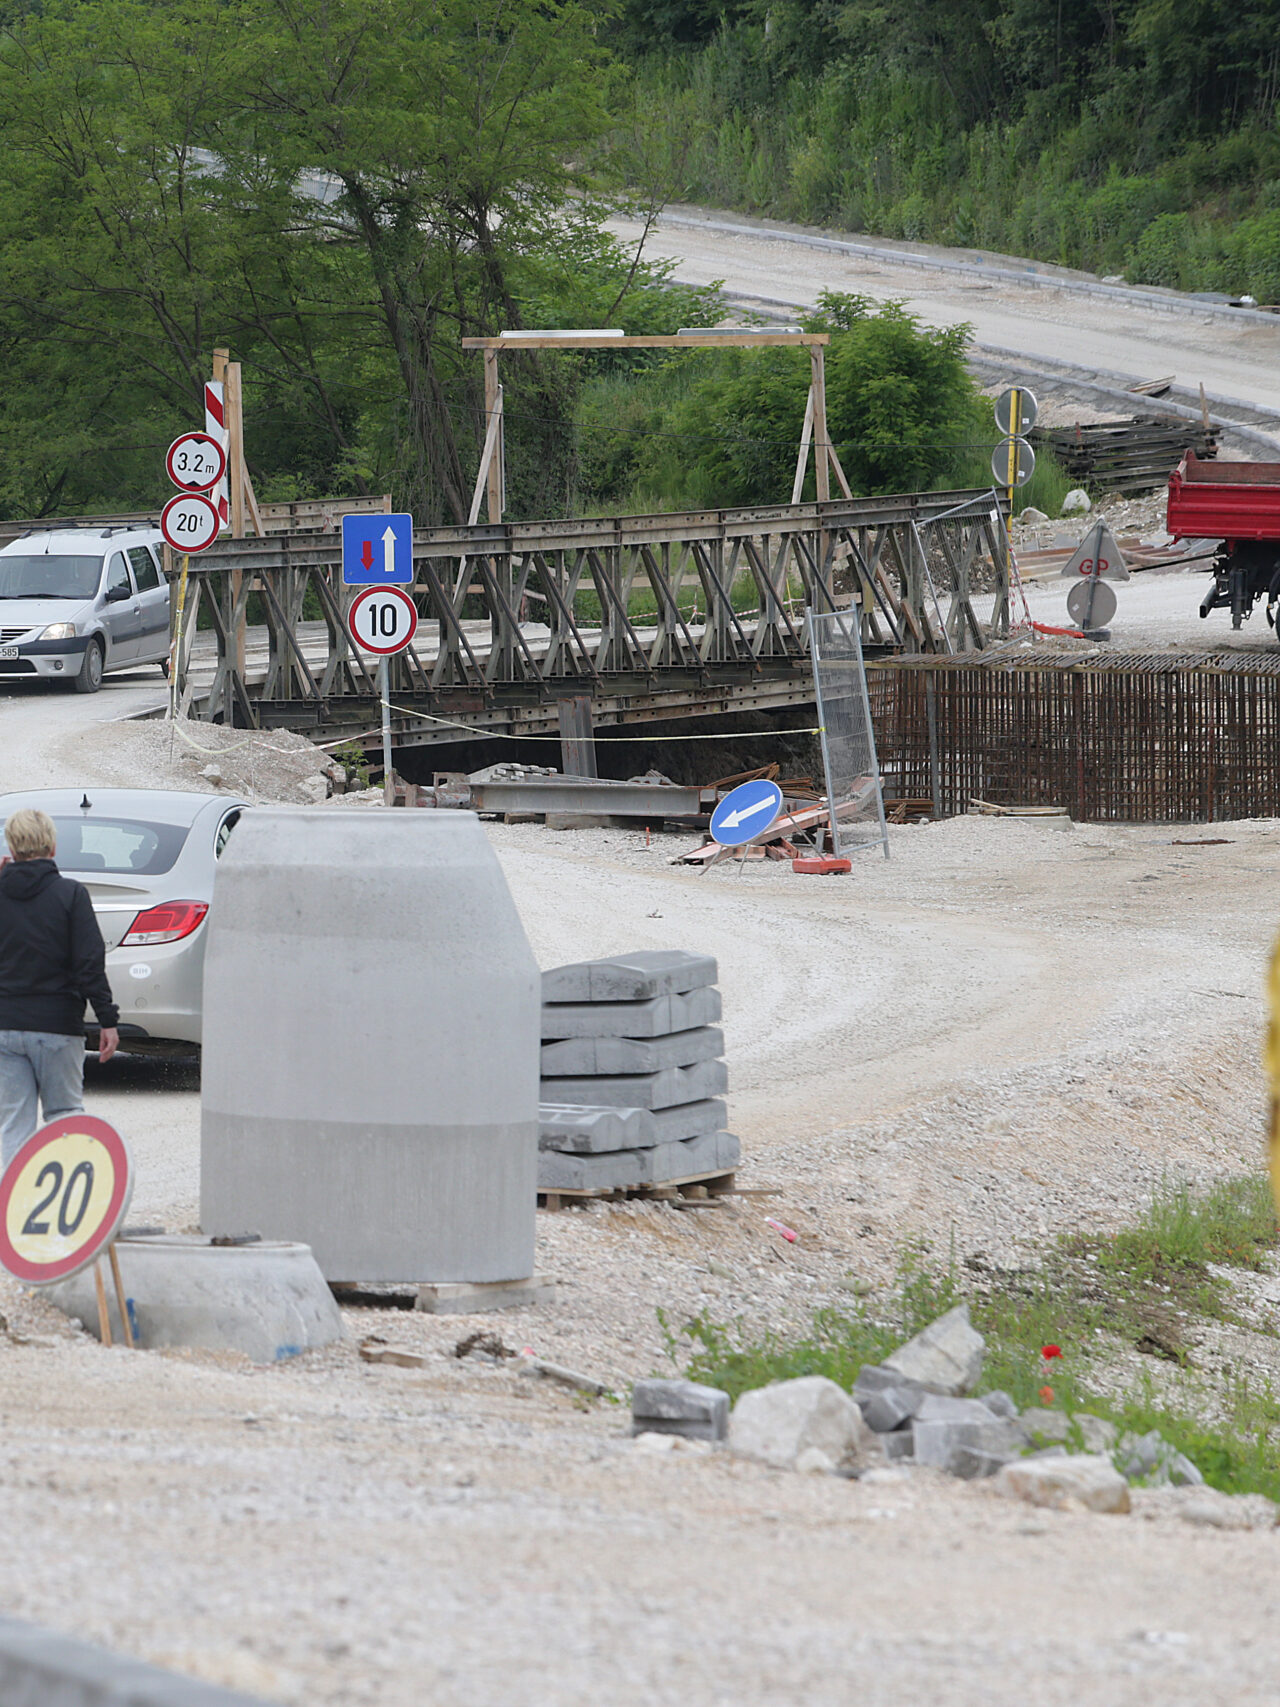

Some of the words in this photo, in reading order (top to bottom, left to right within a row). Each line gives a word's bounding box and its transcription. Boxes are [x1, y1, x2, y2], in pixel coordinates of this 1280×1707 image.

[1079, 558, 1109, 576] GP
[368, 604, 397, 637] 10
[21, 1161, 94, 1236] 20
